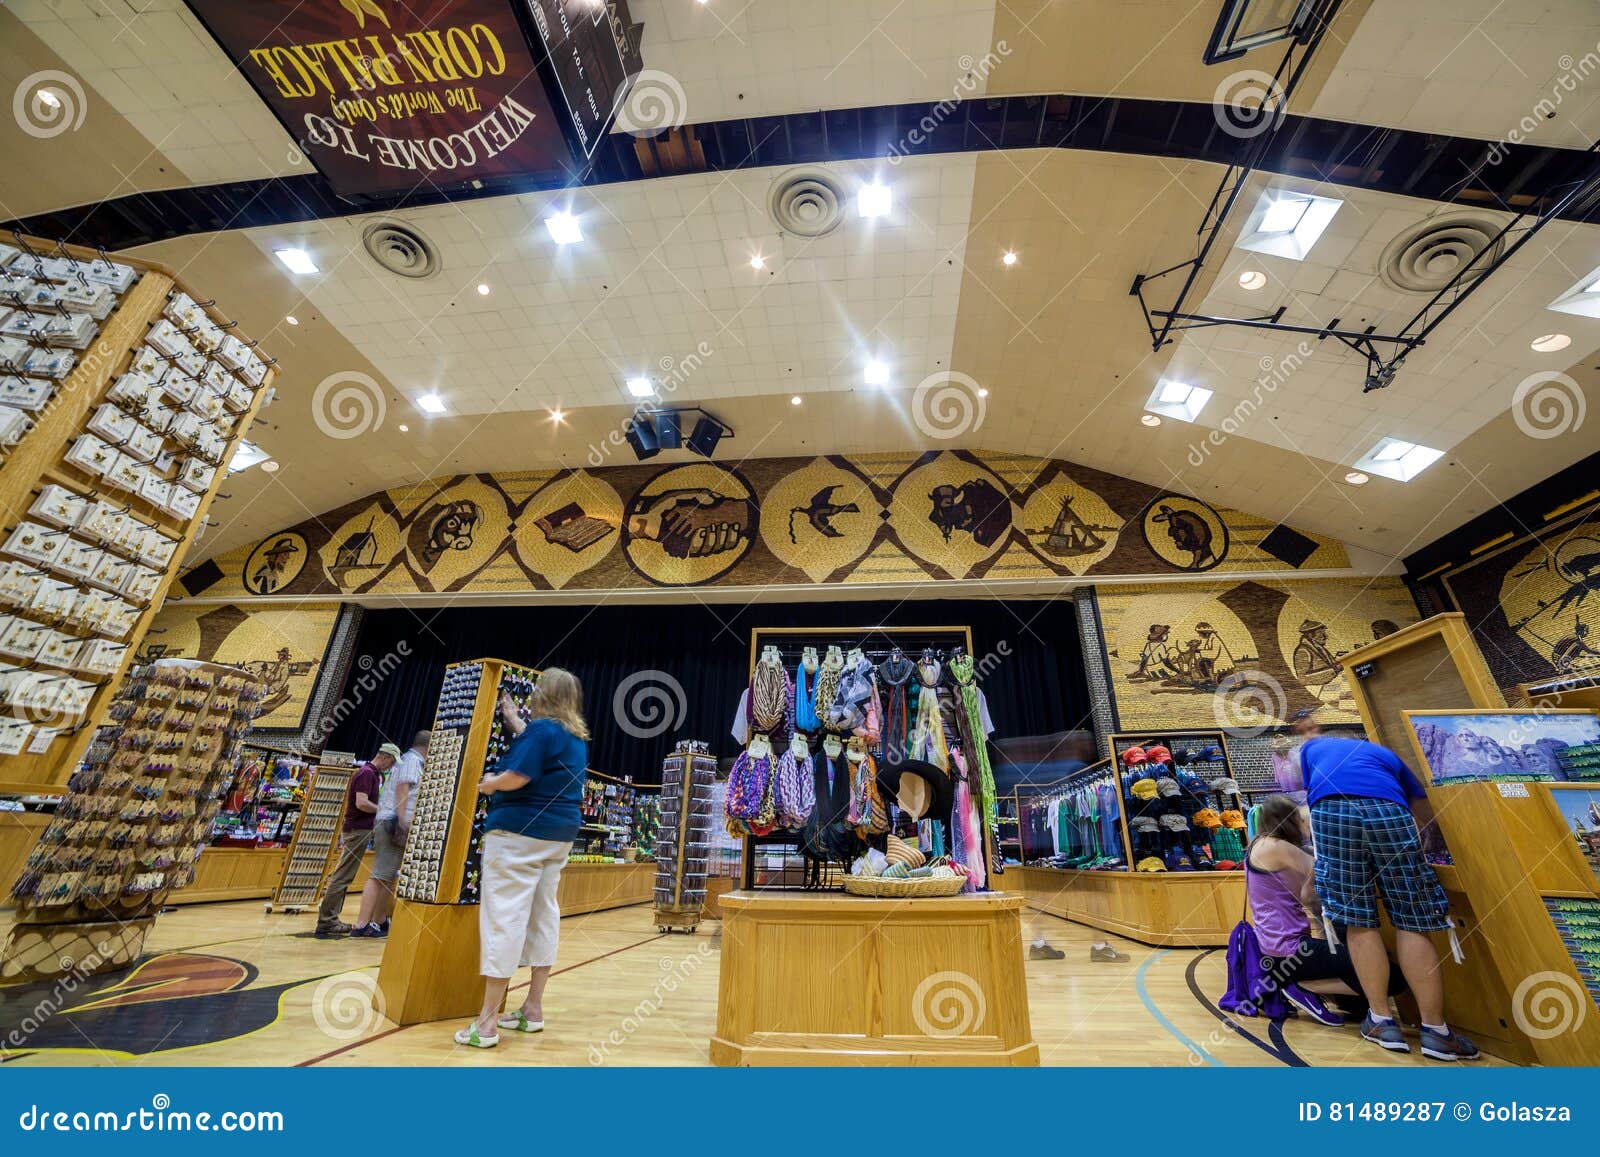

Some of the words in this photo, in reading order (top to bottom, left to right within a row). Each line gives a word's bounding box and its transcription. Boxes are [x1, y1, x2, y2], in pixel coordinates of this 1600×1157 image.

[249, 36, 404, 98] PALACE
[391, 24, 506, 84] CORN
[330, 94, 378, 125] Only
[376, 90, 446, 120] World's
[445, 87, 482, 113] The
[304, 112, 370, 162] TO
[368, 95, 537, 170] WELCOME
